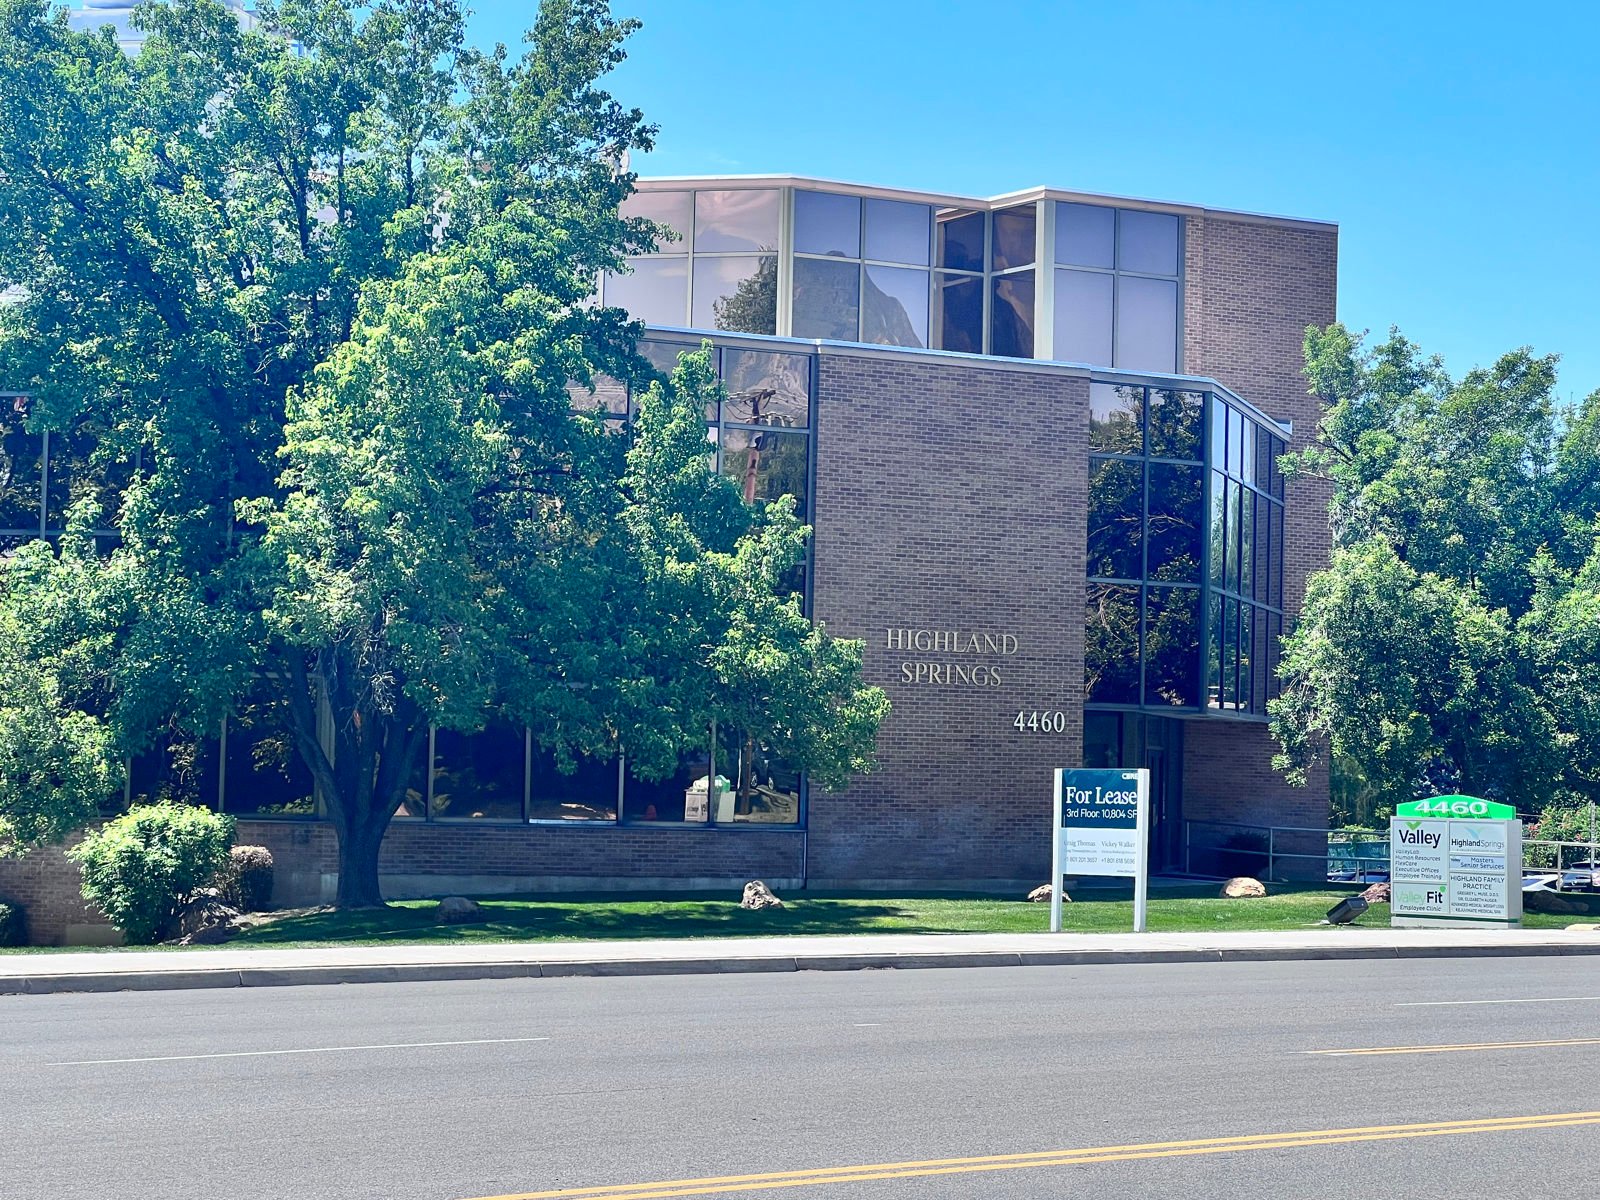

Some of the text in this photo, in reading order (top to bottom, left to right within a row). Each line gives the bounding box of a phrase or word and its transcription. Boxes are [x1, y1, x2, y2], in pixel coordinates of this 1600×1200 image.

[886, 628, 1019, 655] HIGHLAND
[901, 662, 1001, 687] SPRINGS
[1013, 710, 1065, 733] 4460
[1065, 786, 1137, 805] For Lease
[1066, 808, 1079, 818] 3rd
[1080, 808, 1100, 818] Floor:
[1102, 809, 1126, 819] 10,804
[1414, 801, 1488, 815] 4460
[1399, 829, 1441, 849] Valley
[1450, 875, 1482, 883] HIGHLAND
